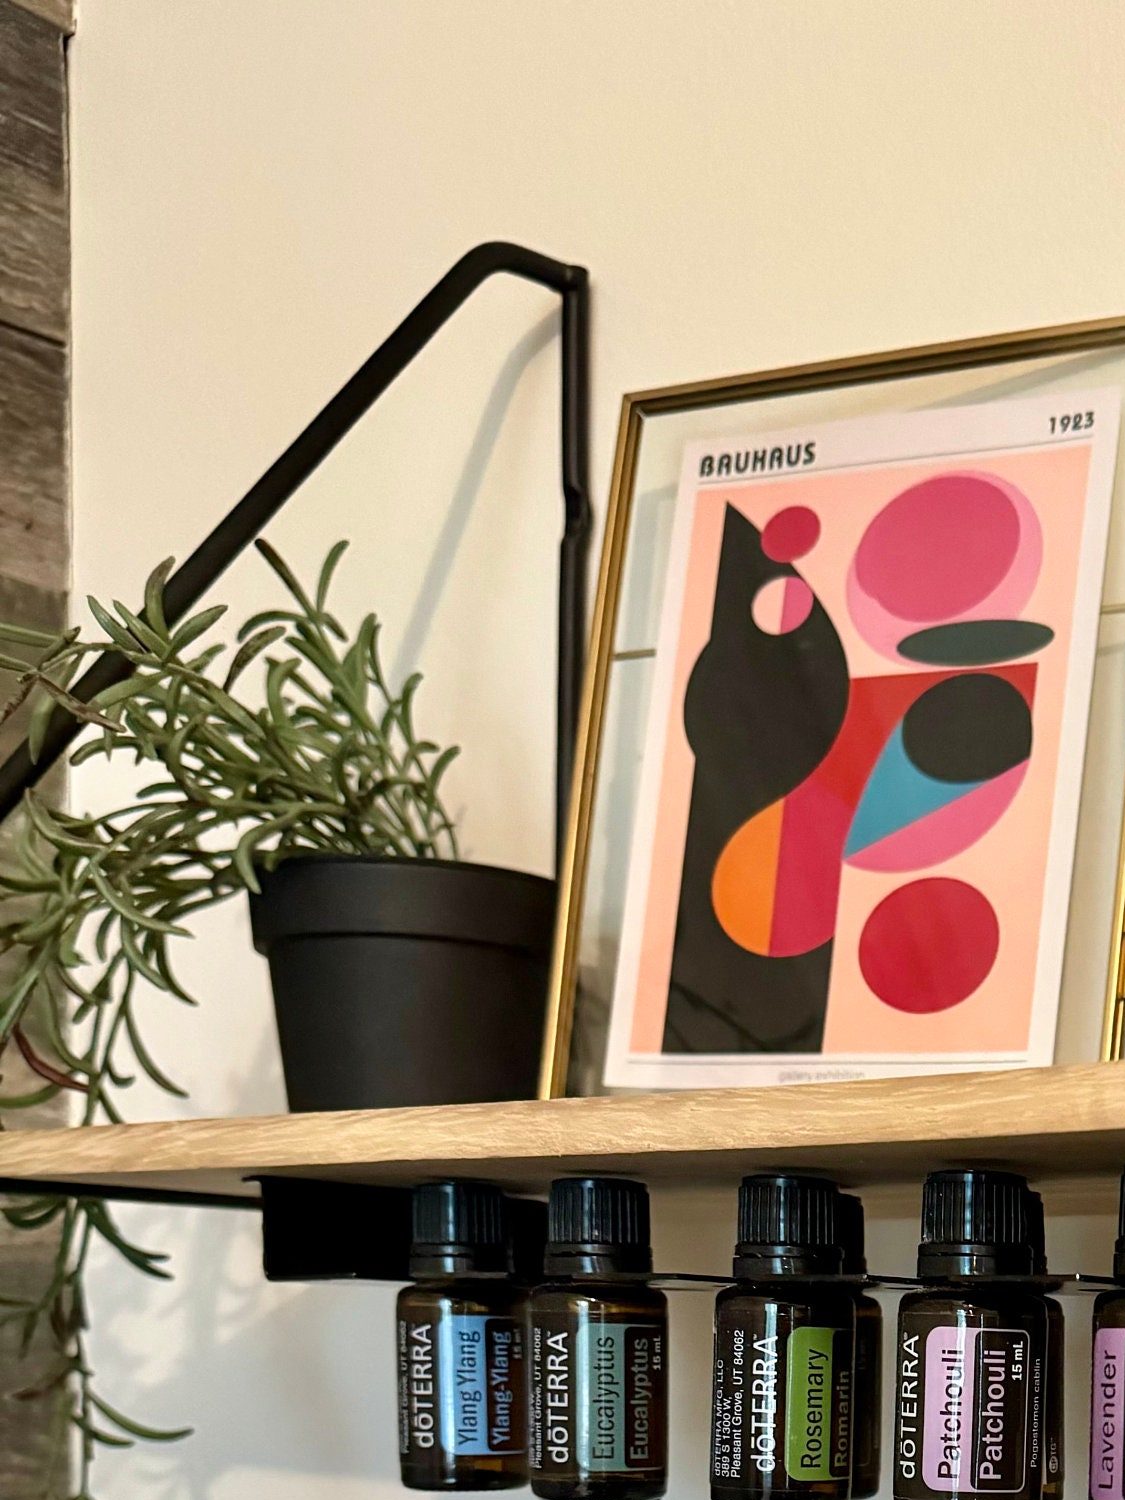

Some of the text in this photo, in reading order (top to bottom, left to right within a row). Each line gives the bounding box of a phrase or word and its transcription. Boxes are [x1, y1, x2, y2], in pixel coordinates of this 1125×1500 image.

[699, 441, 817, 478] BAUHAUS
[1048, 411, 1096, 435] 1923
[456, 1331, 483, 1446] Ylang Ylang
[491, 1331, 514, 1446] Ylang-Ylang
[533, 1365, 543, 1381] UT
[591, 1336, 620, 1460] Eucalyptus
[629, 1338, 653, 1460] Eucalyptus
[716, 1359, 724, 1383] LLC
[730, 1329, 745, 1478] Pleasant Grove, UT 84062
[800, 1348, 829, 1469] Rosemary
[937, 1349, 964, 1479] Patchouli
[979, 1350, 1006, 1480] Patchouli
[1011, 1340, 1024, 1381] 15 mL
[1033, 1358, 1041, 1393] cablin
[721, 1395, 733, 1478] 389 S 1300 W,
[833, 1370, 850, 1468] Romarin
[1098, 1350, 1117, 1490] Lavender
